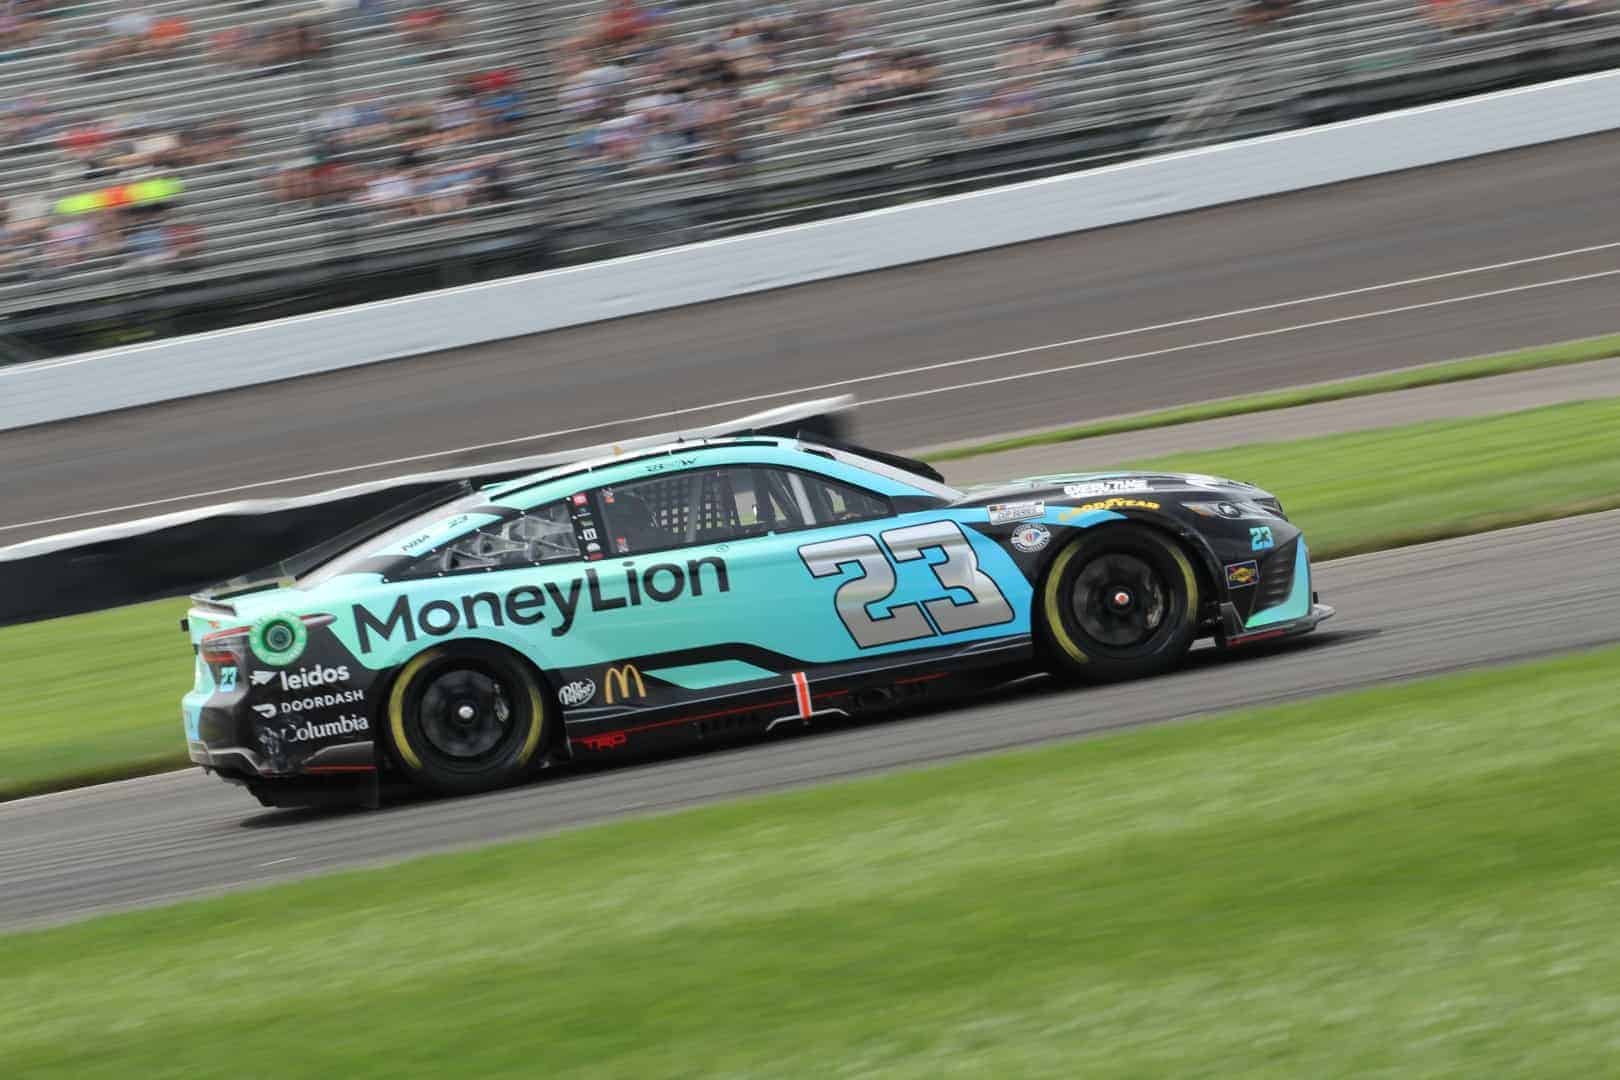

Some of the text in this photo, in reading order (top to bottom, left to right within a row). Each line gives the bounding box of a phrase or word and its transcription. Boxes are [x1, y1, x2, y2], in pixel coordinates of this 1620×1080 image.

[1249, 526, 1274, 552] 23
[797, 519, 1016, 649] 23
[352, 555, 730, 654] MoneyLion
[280, 664, 350, 691] leidos
[280, 689, 364, 714] DOORDASH
